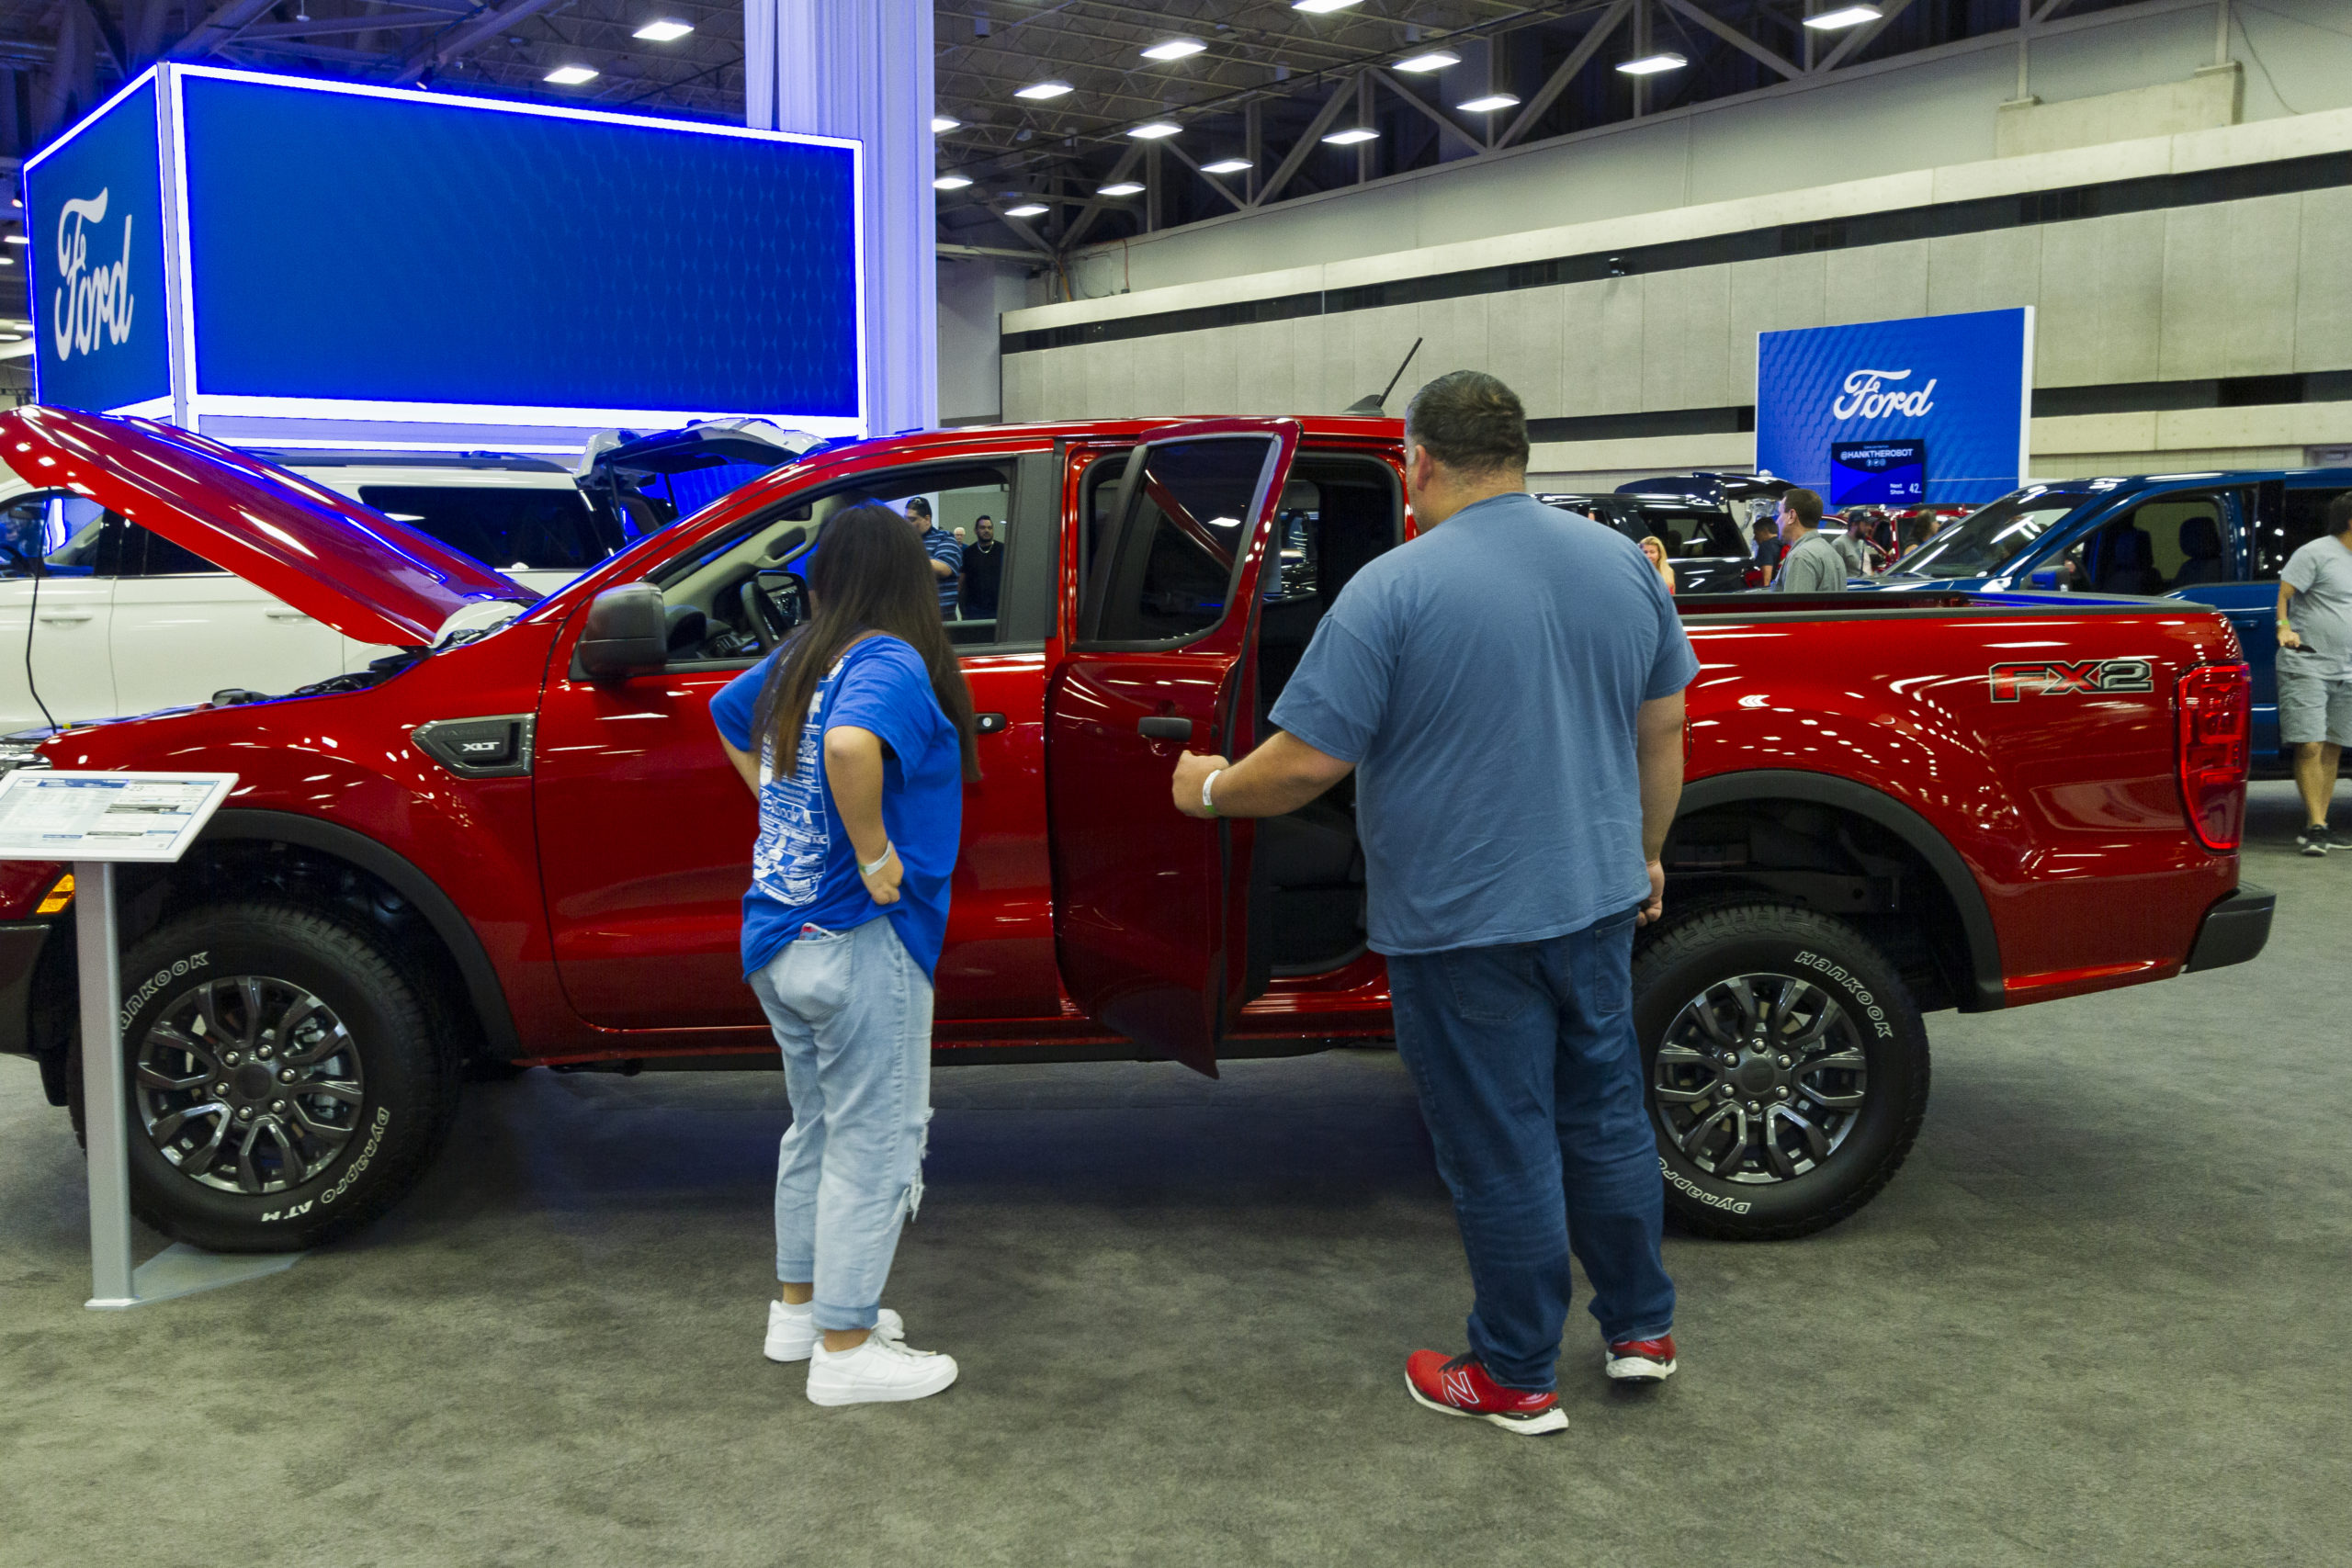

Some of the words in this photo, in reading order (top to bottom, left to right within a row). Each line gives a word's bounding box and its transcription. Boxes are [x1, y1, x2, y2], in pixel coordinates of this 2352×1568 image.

[54, 186, 134, 361] Ford
[1833, 368, 1938, 420] Ford
[1840, 448, 1914, 460] @HANKTHEROBOT
[1989, 660, 2154, 703] FX2
[462, 741, 500, 752] XLT
